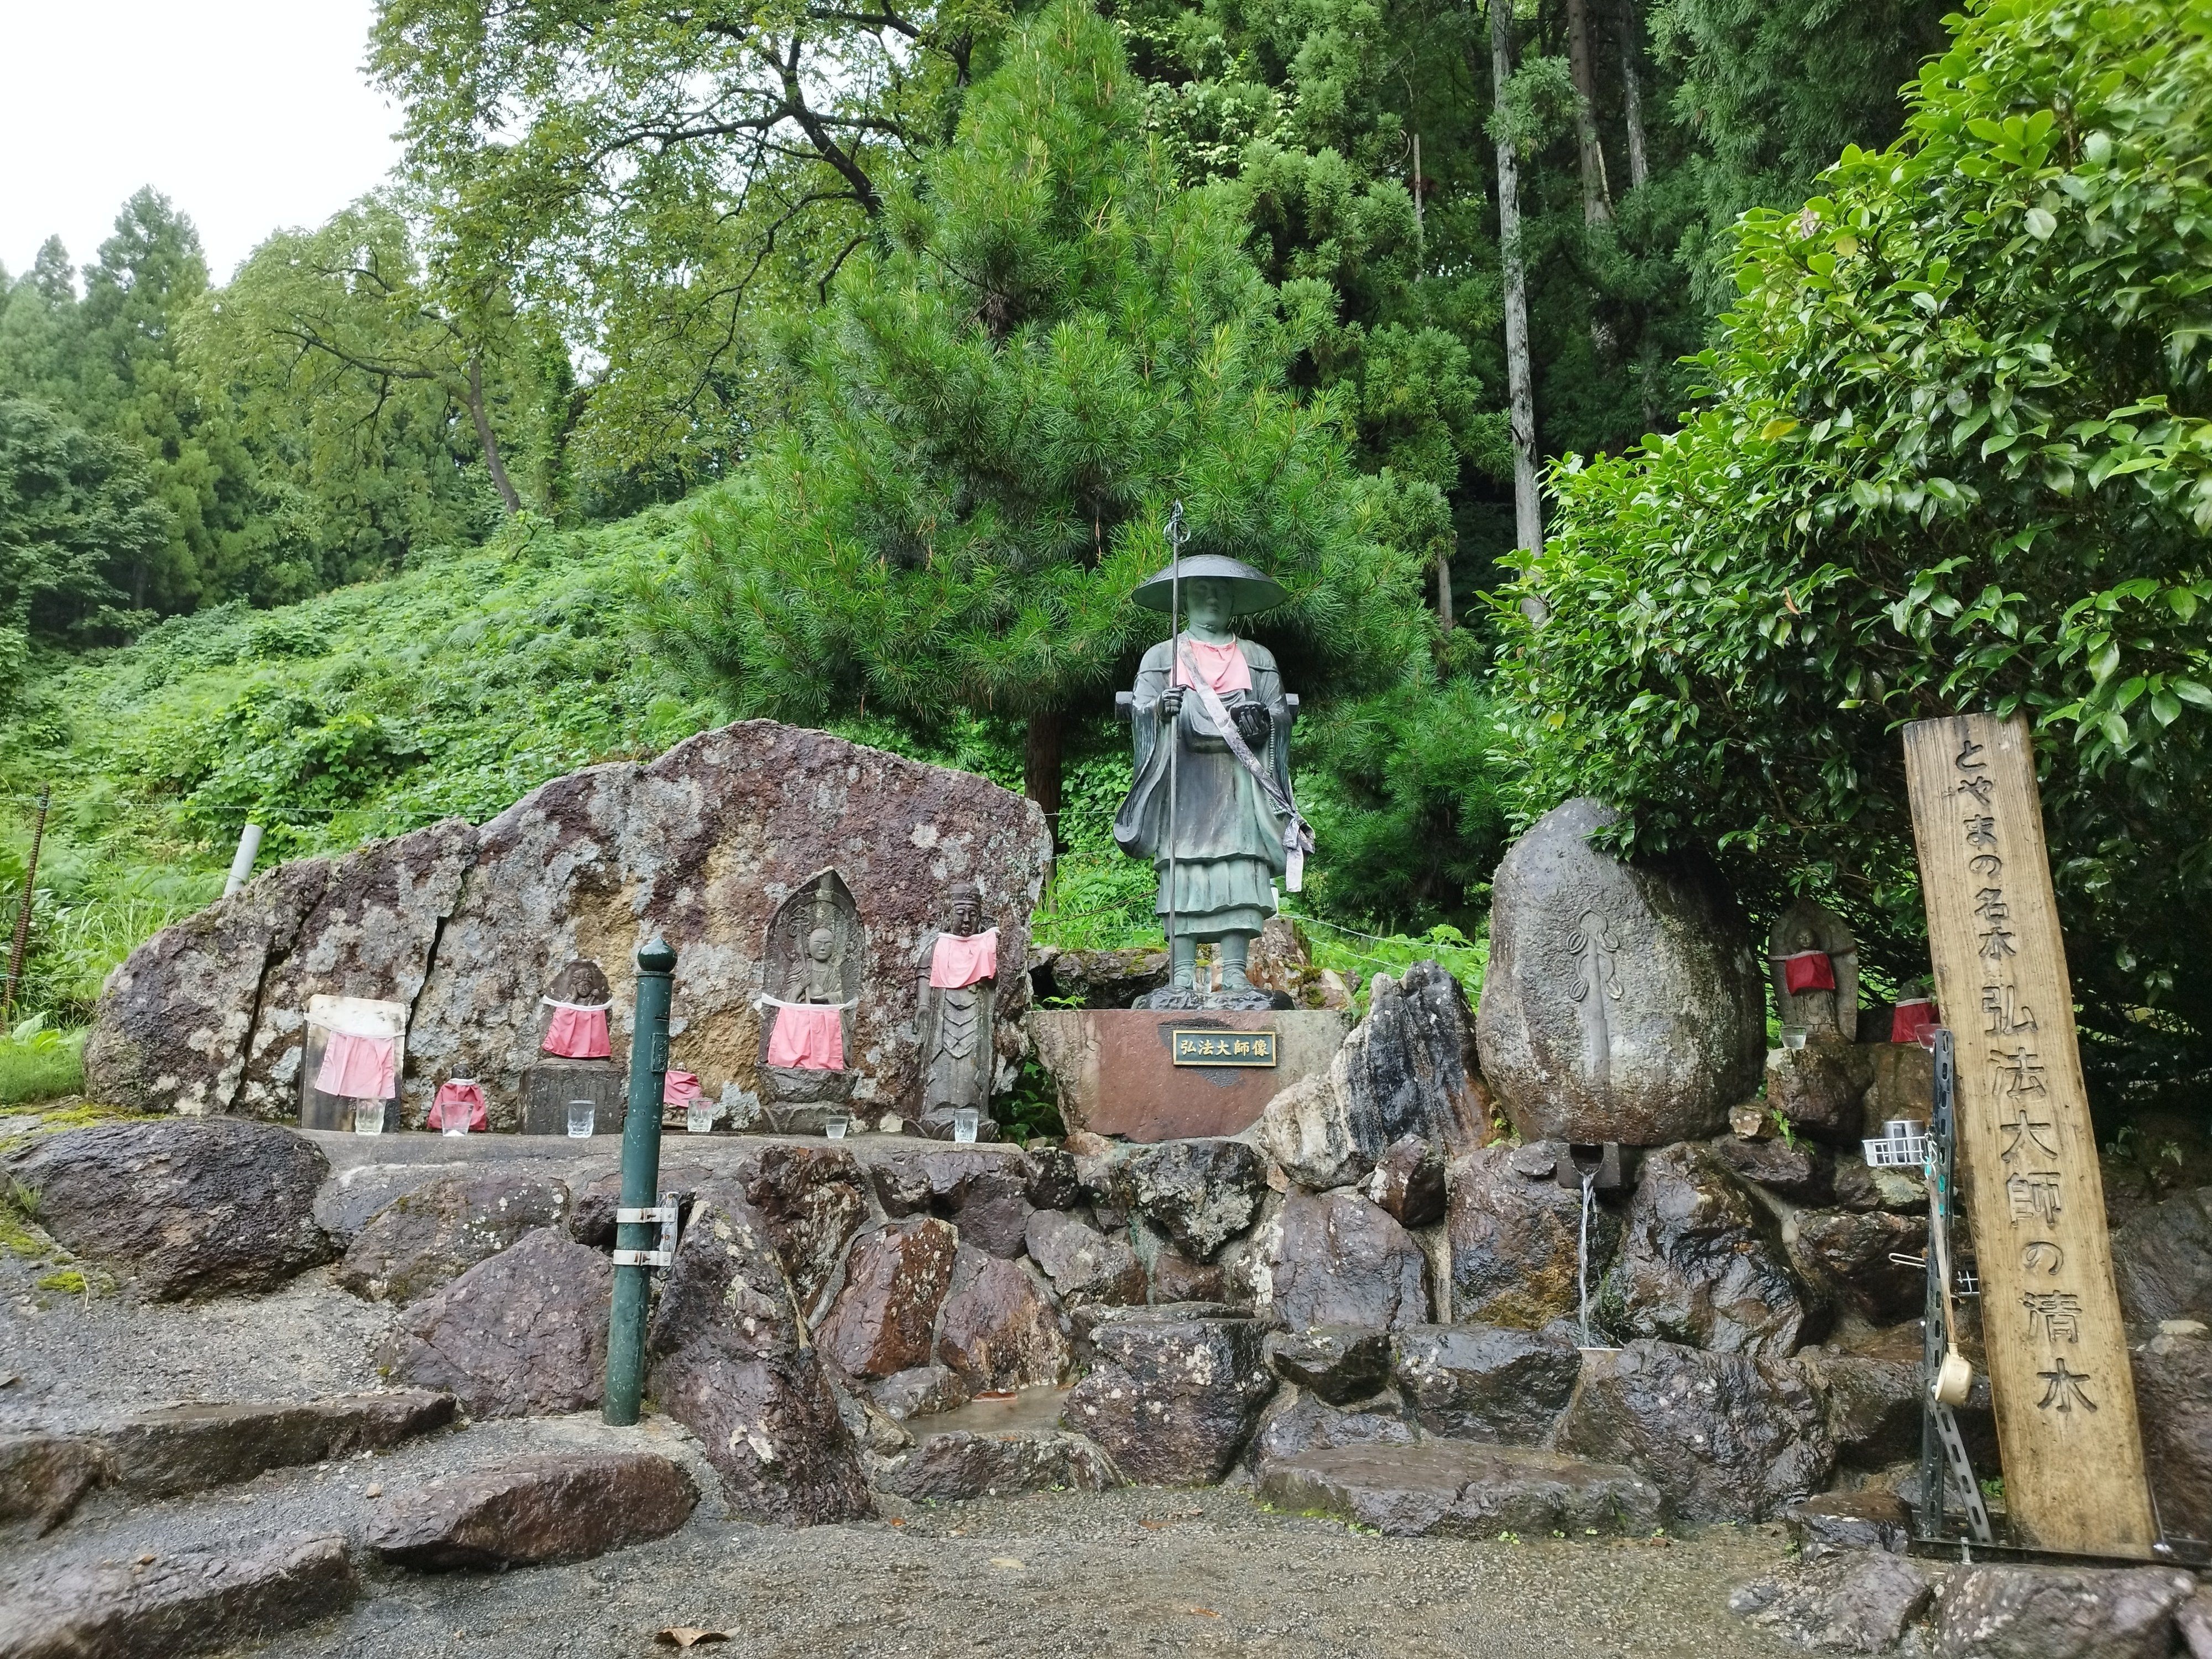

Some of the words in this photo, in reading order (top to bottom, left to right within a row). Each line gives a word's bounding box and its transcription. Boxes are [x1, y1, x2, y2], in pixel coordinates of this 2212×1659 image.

[1180, 1039, 1270, 1057] 弘法大師像
